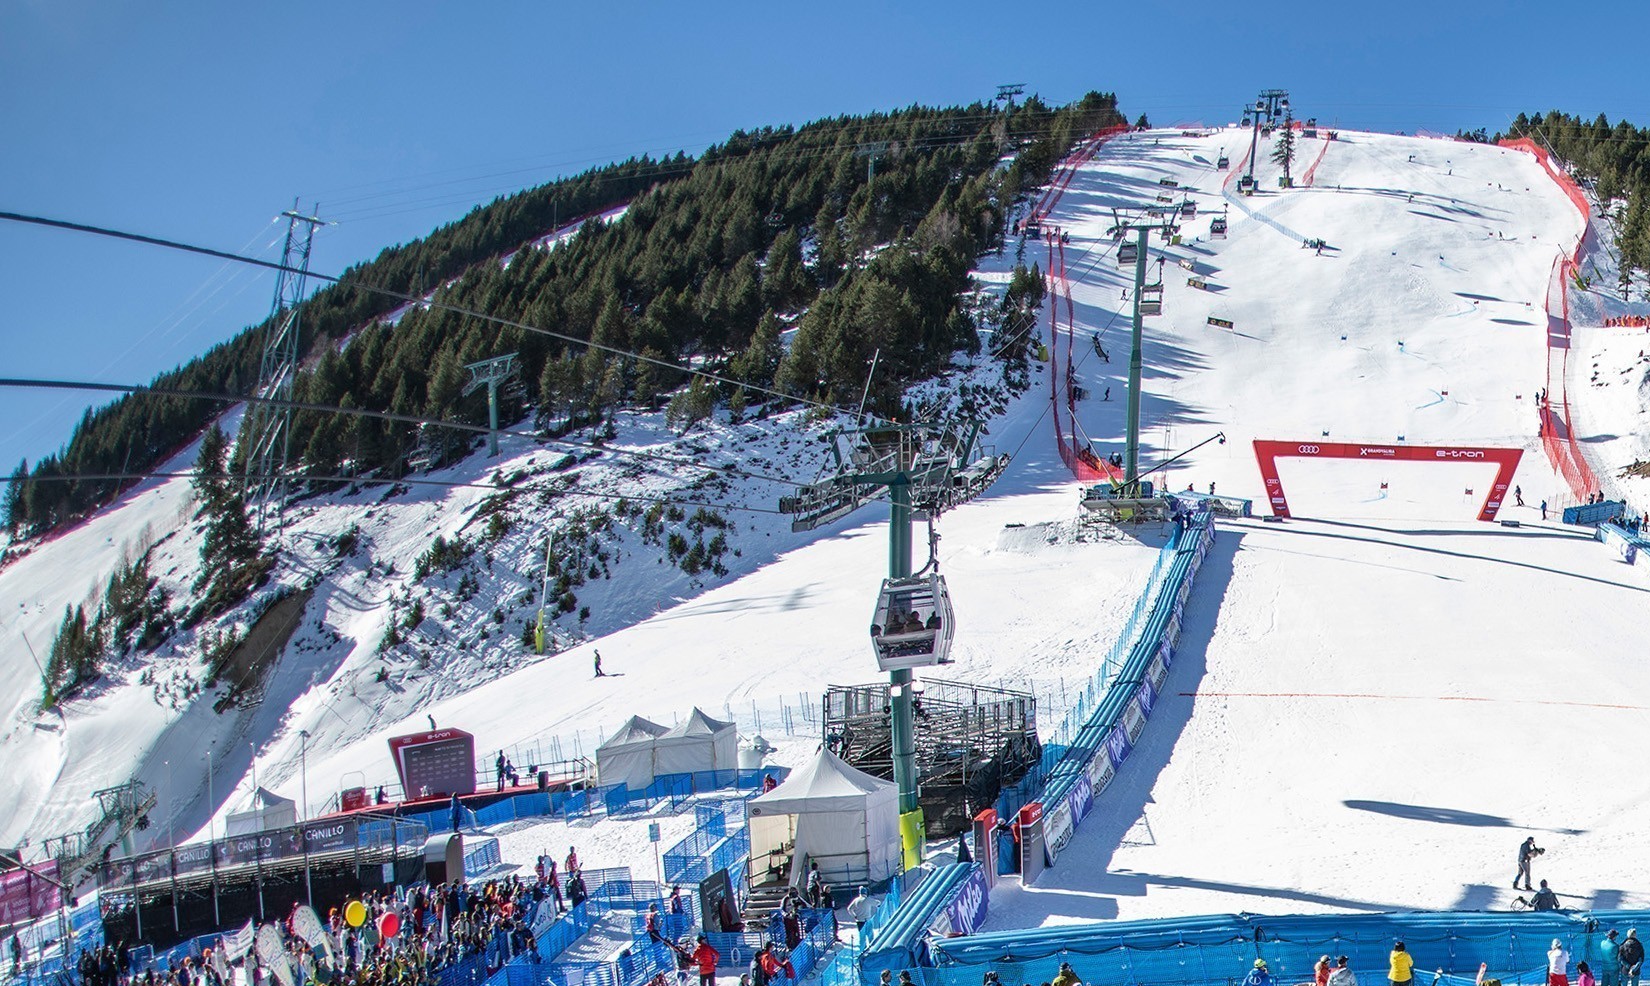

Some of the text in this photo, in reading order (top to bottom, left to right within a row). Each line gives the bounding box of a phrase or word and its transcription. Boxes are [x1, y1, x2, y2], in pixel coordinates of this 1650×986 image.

[1436, 450, 1484, 458] e-tron
[427, 731, 451, 740] e-tron
[305, 825, 344, 841] CANILLO
[238, 837, 272, 852] CANILO
